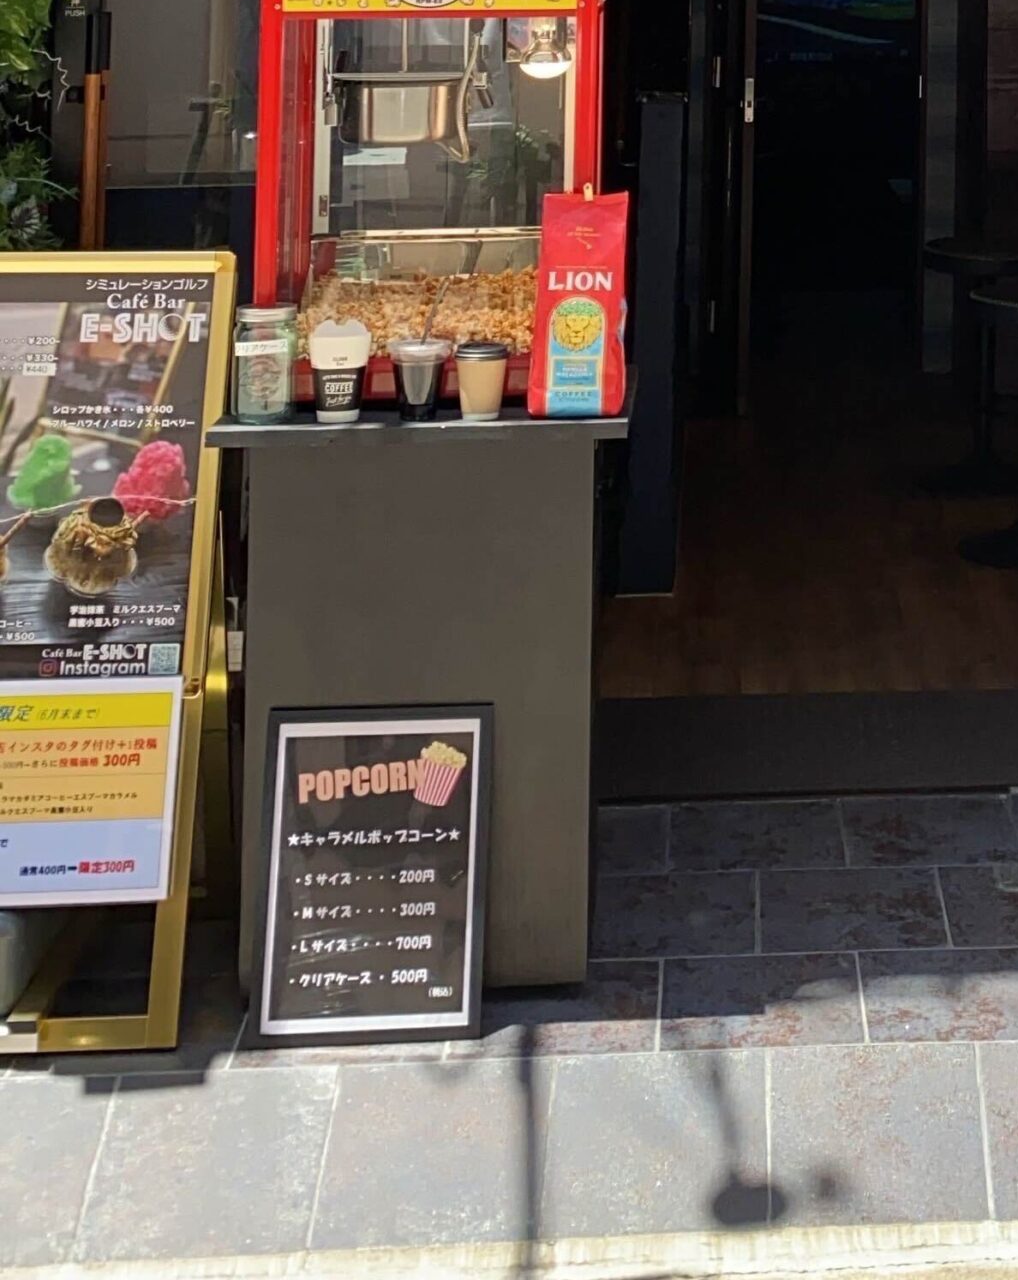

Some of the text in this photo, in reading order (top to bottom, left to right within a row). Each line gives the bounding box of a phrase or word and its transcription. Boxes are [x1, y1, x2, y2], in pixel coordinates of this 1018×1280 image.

[64, 9, 86, 17] PUSH
[86, 278, 209, 291] シミュレーションゴルフ
[547, 271, 613, 291] LION
[106, 293, 186, 309] Café Bar
[79, 313, 207, 343] E-SHOT
[42, 644, 148, 661] Café Bar E-SHOT
[59, 660, 146, 677] Instagram
[103, 753, 141, 767] 300円
[299, 757, 426, 804] POPCORN
